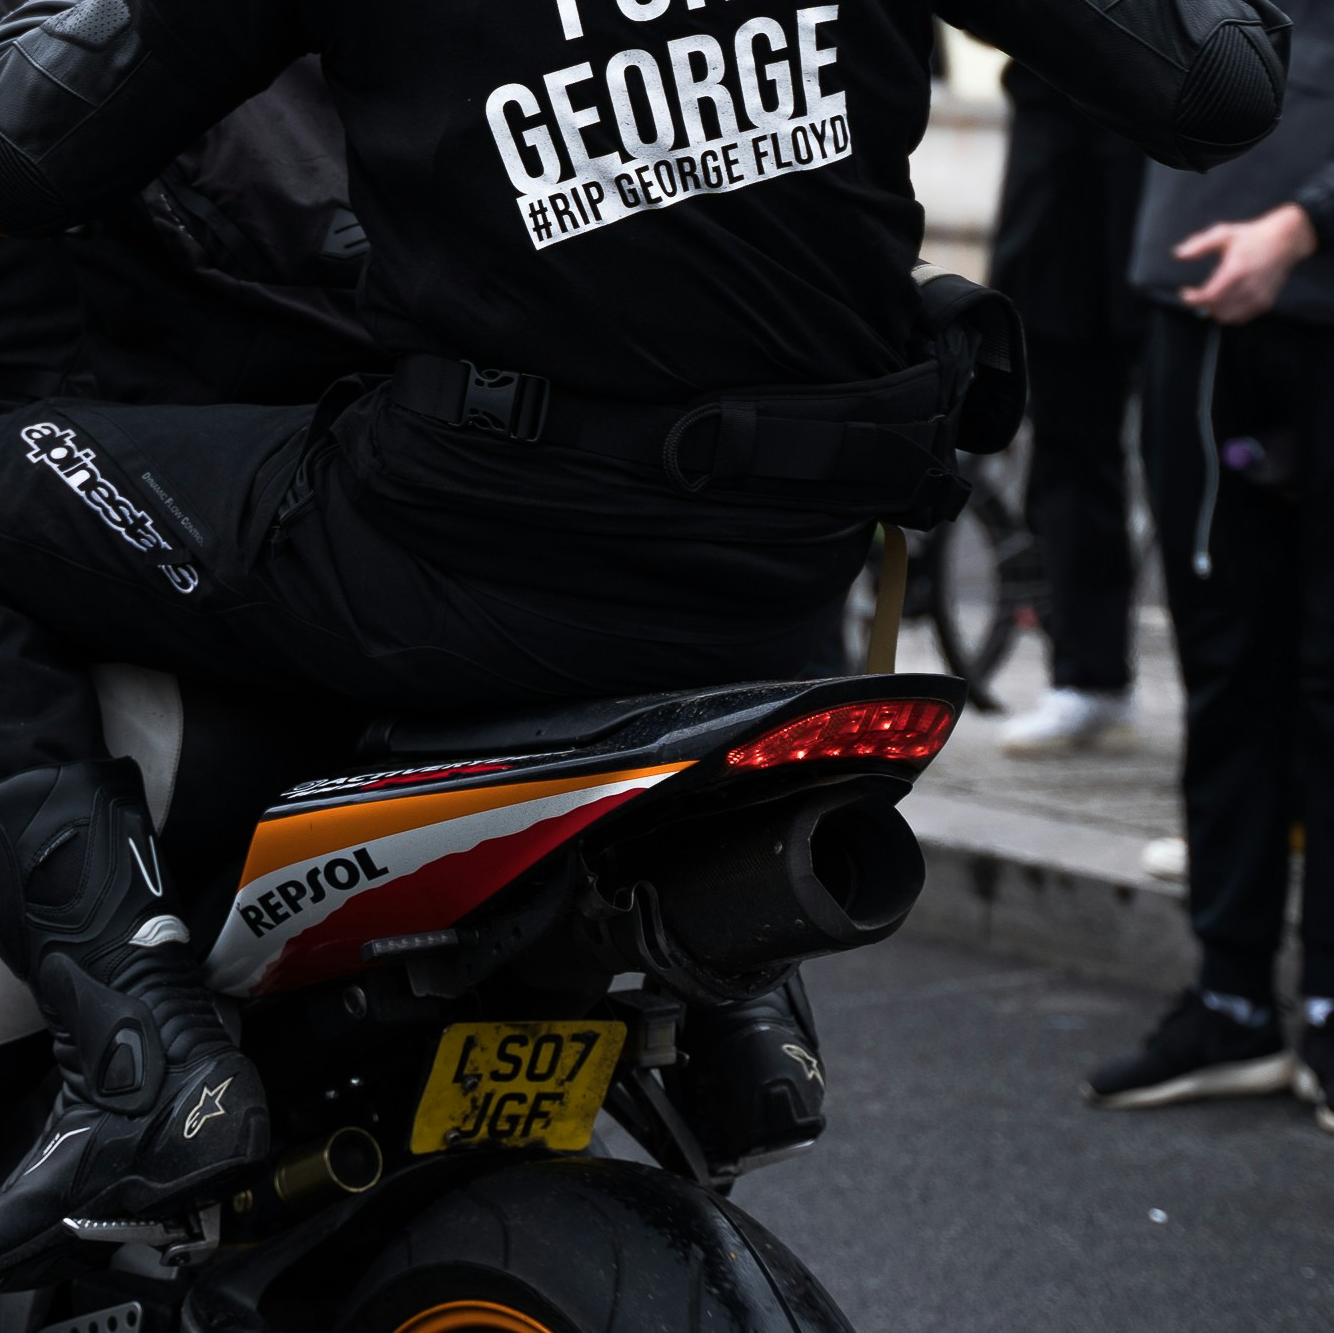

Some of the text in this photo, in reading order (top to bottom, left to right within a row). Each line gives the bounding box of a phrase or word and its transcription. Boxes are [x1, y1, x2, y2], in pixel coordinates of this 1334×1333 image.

[485, 4, 847, 197] GEORGE
[528, 115, 850, 243] #RIP GEORGE FLOYD
[20, 422, 199, 594] alpinestas
[239, 846, 390, 939] REPSOL
[452, 1032, 602, 1085] LS07
